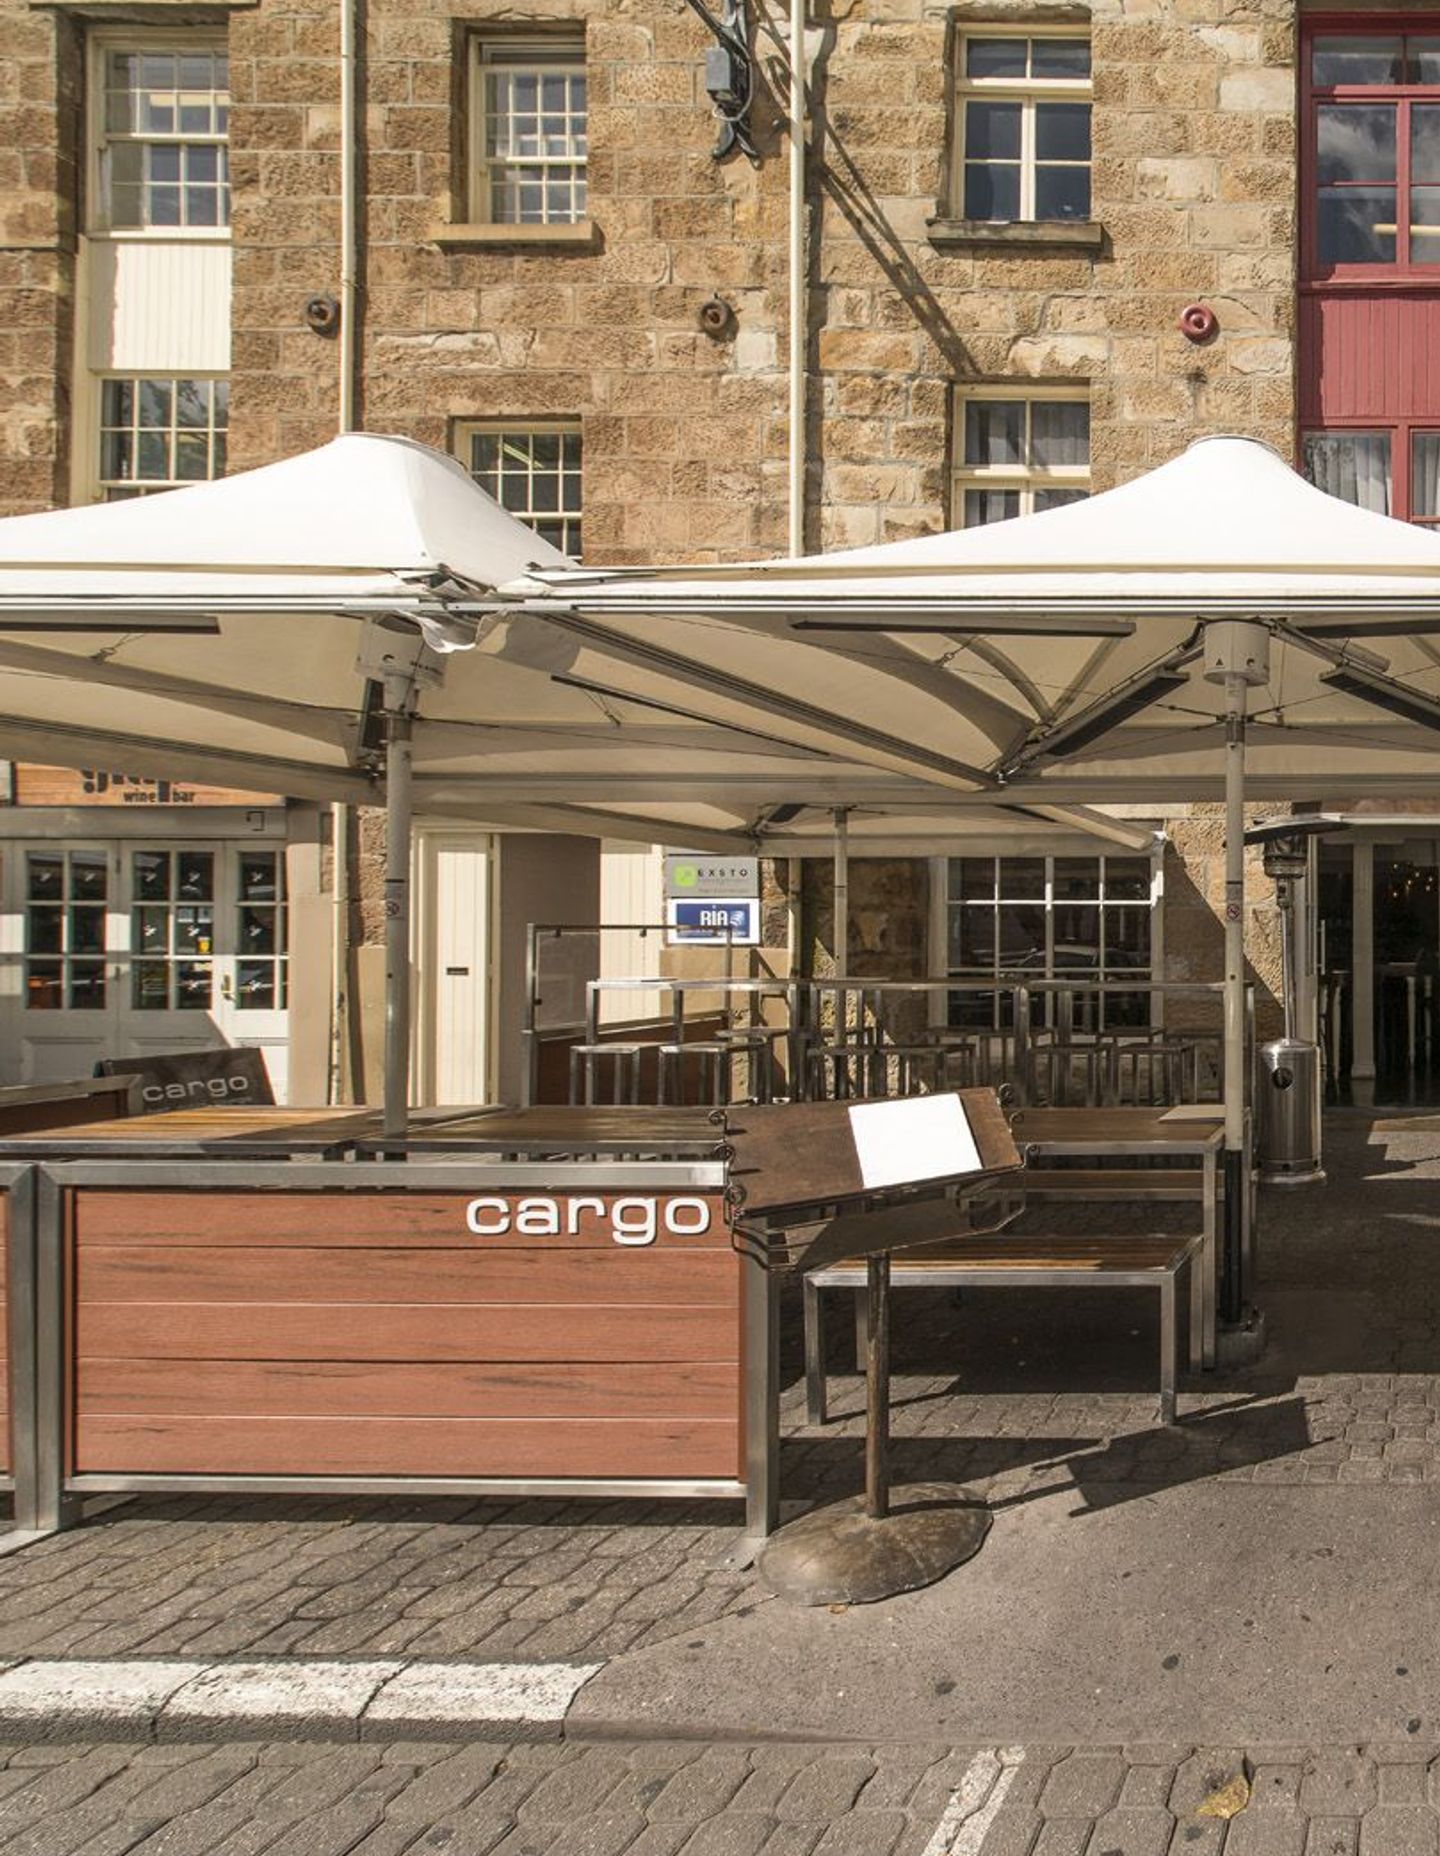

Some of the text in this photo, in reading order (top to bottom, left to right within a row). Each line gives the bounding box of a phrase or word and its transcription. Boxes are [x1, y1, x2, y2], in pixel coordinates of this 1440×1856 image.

[123, 787, 195, 802] wine bar
[697, 868, 748, 877] EXSTO
[142, 1076, 249, 1102] cargo
[465, 1197, 712, 1247] cargo
